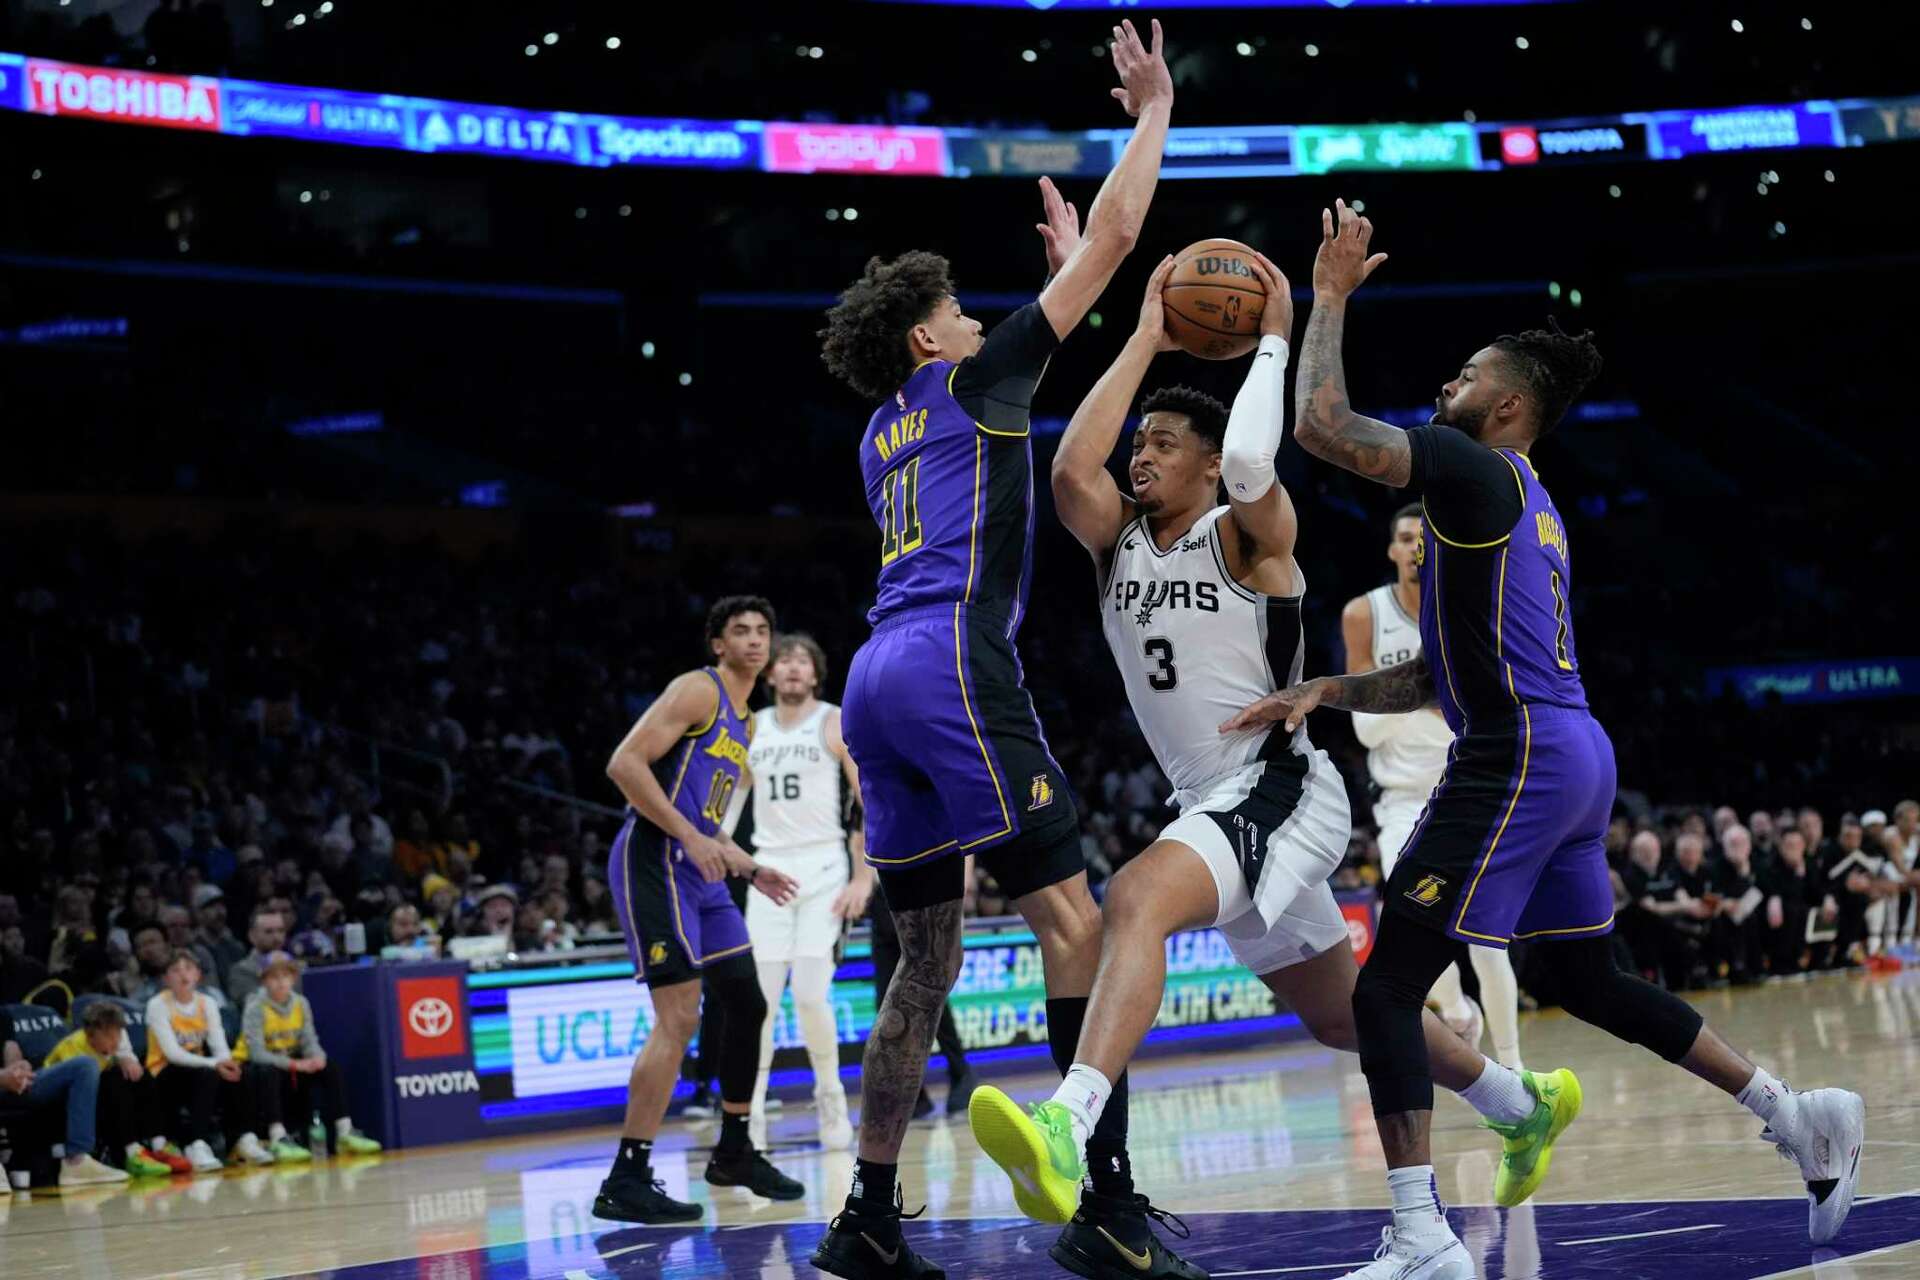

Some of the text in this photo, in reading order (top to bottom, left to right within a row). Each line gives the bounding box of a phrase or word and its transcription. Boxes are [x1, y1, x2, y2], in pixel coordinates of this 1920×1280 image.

[33, 69, 215, 123] TOSHIBA
[322, 104, 400, 134] ULTRA
[456, 113, 571, 153] DELTA
[598, 121, 742, 163] Spectrum
[1539, 128, 1624, 154] TOYOTA
[873, 408, 929, 463] HAYES
[881, 455, 923, 567] 11
[1114, 579, 1220, 627] SPURS
[1551, 570, 1574, 671] 1
[1143, 635, 1180, 693] 3
[1828, 666, 1900, 691] ULTRA
[751, 743, 821, 768] SPURS
[702, 768, 735, 825] 10
[768, 773, 800, 801] 16
[1212, 977, 1276, 1022] CARE
[395, 1071, 480, 1098] TOYOTA
